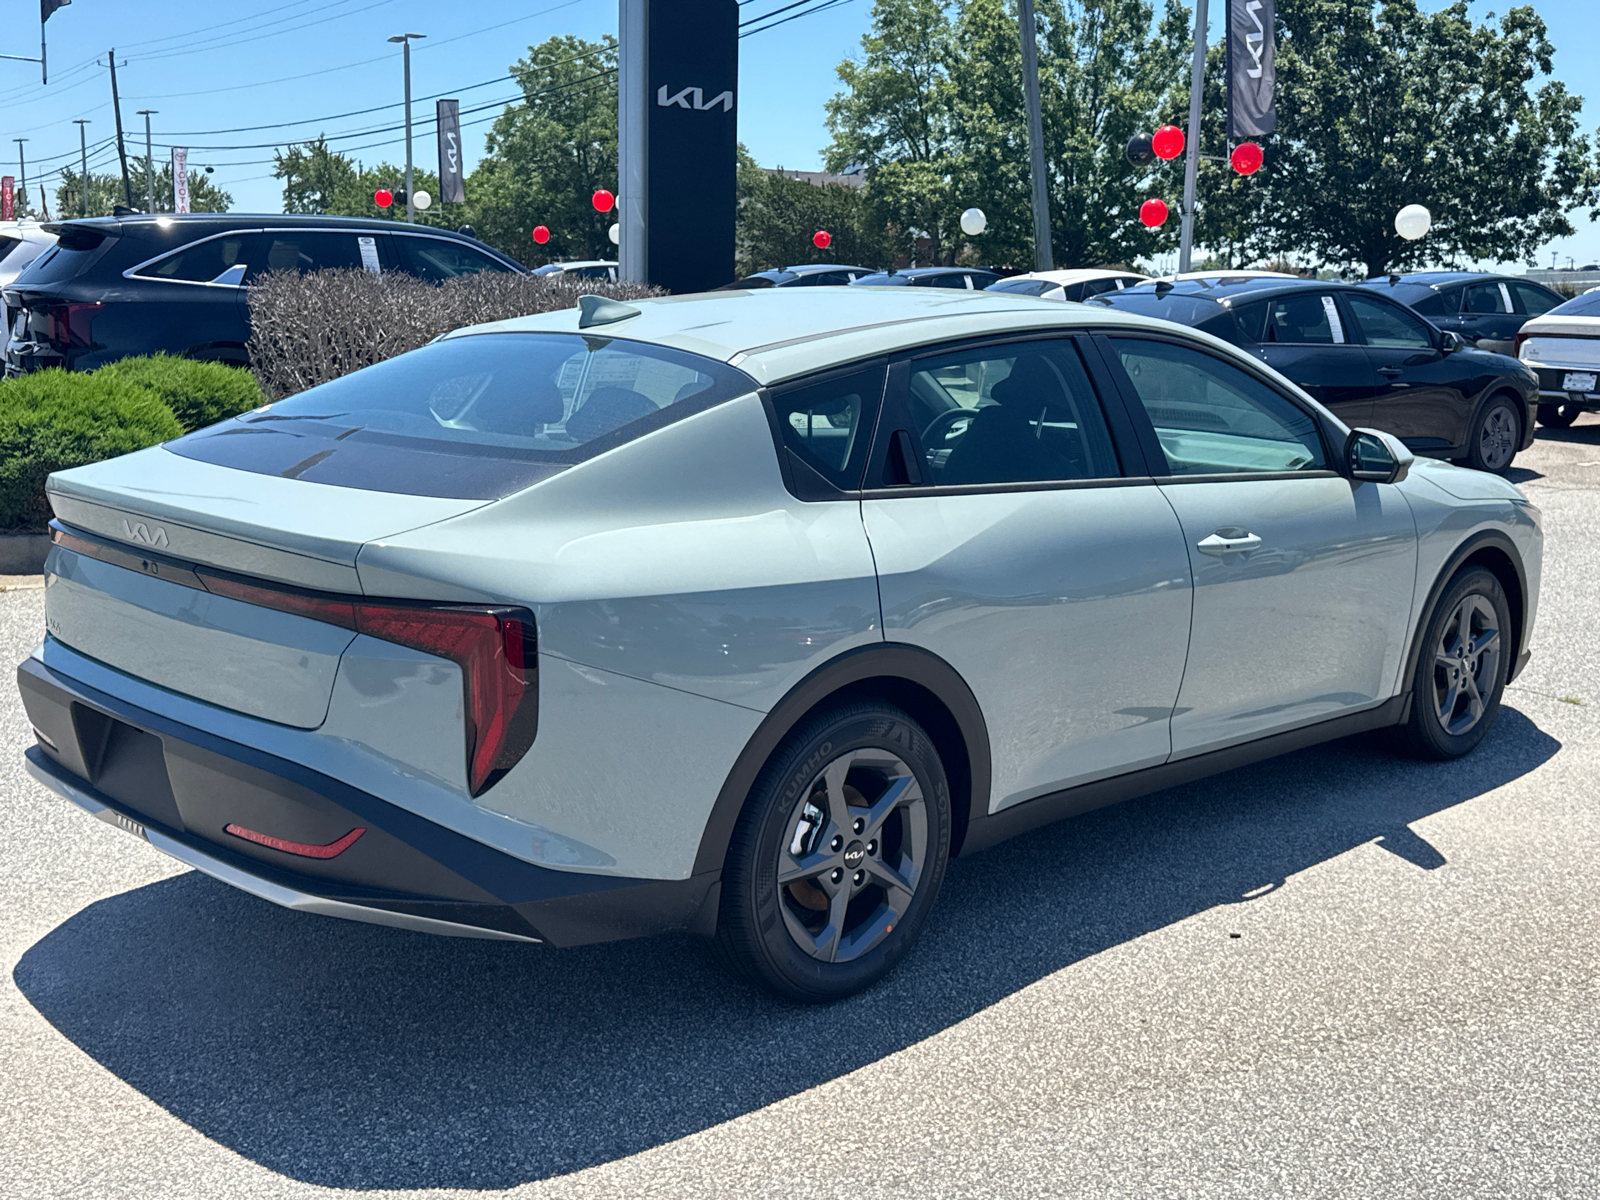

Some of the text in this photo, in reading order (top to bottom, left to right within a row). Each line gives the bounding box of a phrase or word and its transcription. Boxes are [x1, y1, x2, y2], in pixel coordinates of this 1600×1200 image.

[657, 84, 733, 113] KIA
[178, 163, 187, 213] TOYOTA
[124, 518, 169, 548] KIA
[778, 741, 832, 815] KUMHO
[935, 781, 948, 859] SOLUS
[844, 850, 864, 860] KIA
